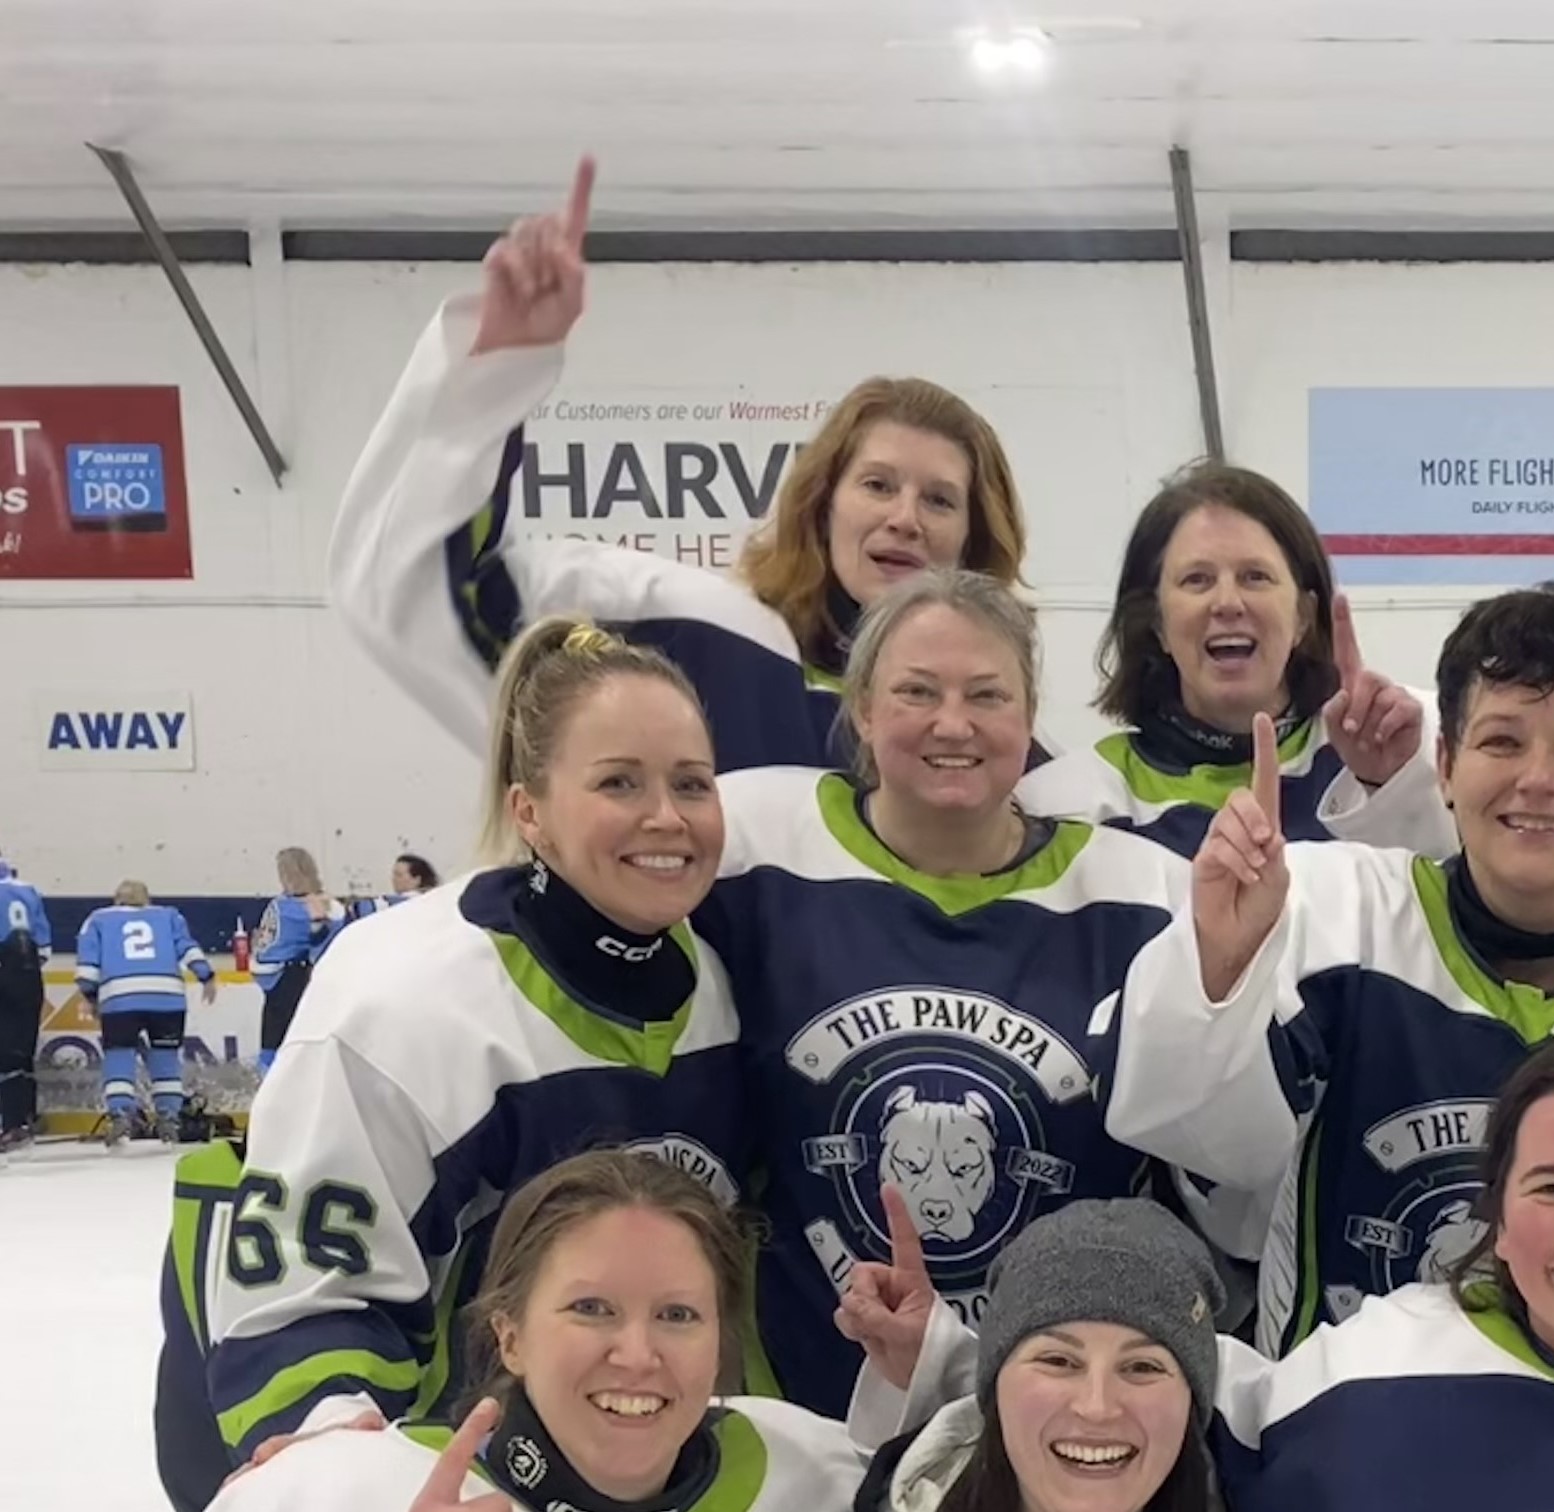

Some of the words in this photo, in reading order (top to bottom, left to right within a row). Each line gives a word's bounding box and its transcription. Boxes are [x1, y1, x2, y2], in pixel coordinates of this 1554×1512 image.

[554, 400, 651, 420] Customers
[657, 404, 687, 420] are
[692, 404, 723, 420] our
[729, 401, 809, 421] Warmest
[92, 452, 150, 465] DAIKIN
[1419, 458, 1480, 487] MORE
[73, 468, 156, 481] COMFORT
[521, 442, 808, 519] HARV
[83, 481, 151, 511] PRO
[1471, 500, 1512, 515] DAILY
[47, 711, 186, 752] AWAY
[121, 919, 156, 960] 2
[826, 1000, 901, 1051] THE
[911, 996, 989, 1035] PAW
[989, 1017, 1051, 1070] SPA
[1405, 1111, 1471, 1153] THE
[815, 1144, 849, 1161] EST
[1018, 1155, 1063, 1179] 2022
[224, 1168, 379, 1287] 66
[1359, 1215, 1396, 1245] EST
